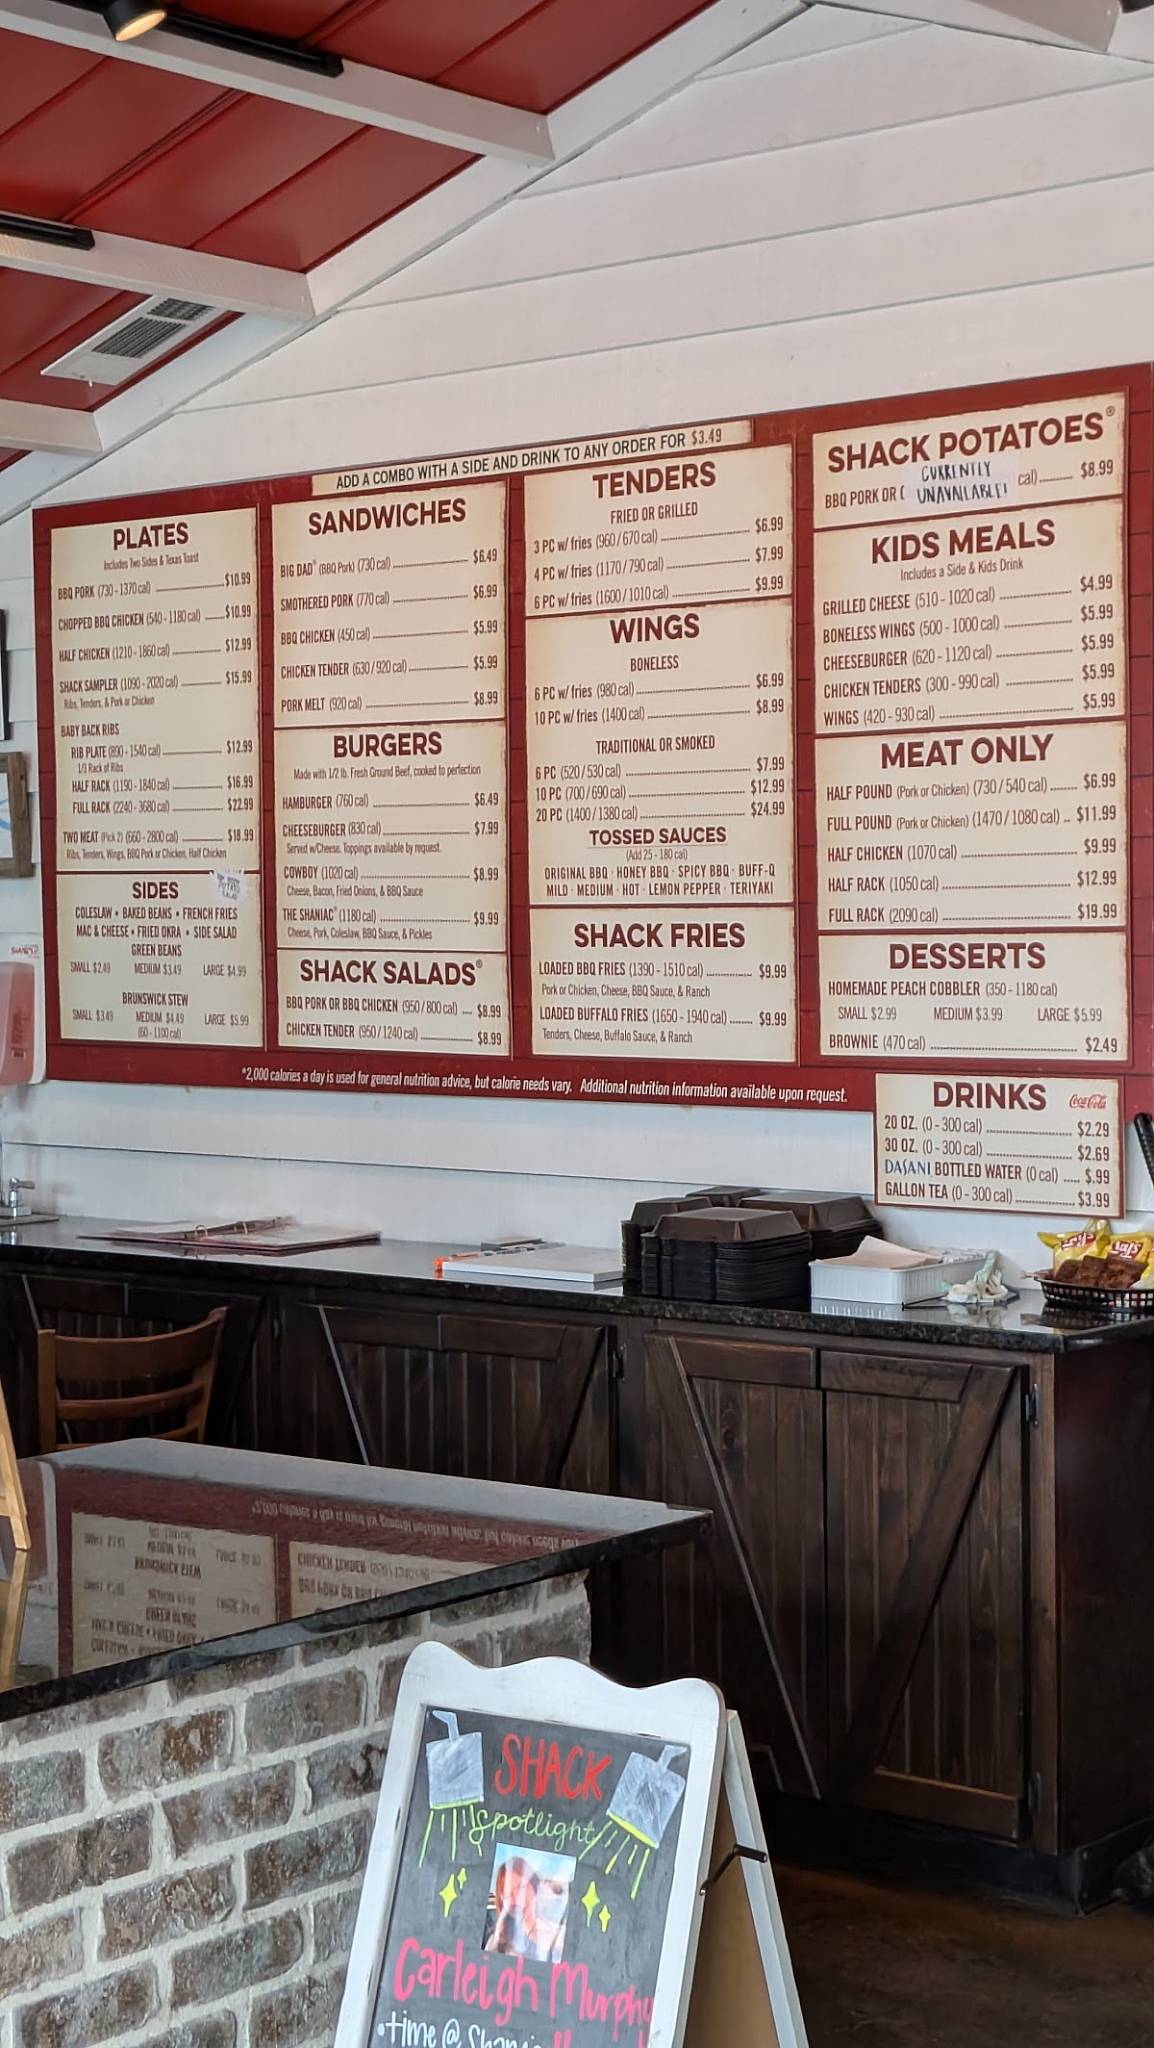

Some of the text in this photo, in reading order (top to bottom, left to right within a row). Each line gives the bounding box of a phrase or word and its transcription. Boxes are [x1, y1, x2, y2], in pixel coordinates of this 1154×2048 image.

[336, 428, 722, 489] ADD A COMBO WITH A SIDE AND DRINK TO ANY ORDER FOR $3.49
[828, 434, 930, 473] SHACK
[592, 461, 716, 498] TENDERS
[922, 461, 991, 481] CURRENTLY
[826, 492, 846, 509] BBQ
[850, 488, 879, 506] PORK
[882, 487, 896, 502] OR
[1081, 459, 1113, 479] $8.99
[309, 498, 466, 535] SANDWICHES
[611, 502, 698, 524] FRIED OR GRILLED
[114, 522, 188, 550] PLATES
[872, 519, 1055, 564] KIDS MEALS
[58, 572, 250, 600] BBQ PORK $10.99
[281, 584, 497, 612] SMOTHERED PORK $6.99
[823, 574, 1112, 616] GRILLED CHEESE $4.99
[58, 604, 251, 631] CHOPPED BBQ CHICKEN $10.99
[610, 613, 699, 644] WINGS
[823, 604, 1113, 644] BONELESS WINGS $5.99
[281, 620, 497, 646] BBQ CHICKEN $5.99
[59, 637, 251, 663] HALF CHICKEN $12.99
[824, 633, 1114, 671] CHEESEBURGER $5.99
[281, 655, 497, 679] CHICKEN TENDER $5.99
[631, 655, 678, 672] BONELESS
[60, 670, 252, 694] SHACK SAMPLER $15.99
[824, 663, 1114, 699] CHICKEN TENDERS $5.99
[281, 691, 498, 712] PORK MELT $8.99
[61, 723, 119, 738] BABY BACK RIBS
[334, 732, 442, 758] BURGERS
[596, 735, 715, 754] TRADITIONAL OR SMOKED
[882, 734, 1053, 769] MEAT ONLY
[827, 772, 1116, 801] HALF POUND $6.99
[282, 792, 498, 810] HAMBURGER $6.49
[536, 801, 784, 822] 20 PC $24.99
[282, 821, 498, 837] CHEESEBURGER $7.99
[828, 805, 1116, 832] FULL POUND $11.99
[589, 826, 726, 846] TOSSED SAUCES
[828, 838, 1116, 862] HALF CHICKEN $9.99
[284, 866, 498, 882] COWBOY $8.99
[133, 882, 178, 899] SIDES
[76, 906, 238, 920] COLESLAW BAKED BEANS FRENCH FRIES
[574, 923, 745, 948] SHACK FRIES
[890, 942, 1045, 969] DESSERTS
[300, 959, 377, 984] SHACK
[539, 961, 786, 980] LOADED BBQ FRIES $9.99
[122, 992, 188, 1006] BRUNSWICK STEW
[828, 981, 980, 996] HOMEMADE PEACH COBBLER
[540, 1006, 786, 1026] LOADED BUFFALO FRIES $9.99
[830, 1034, 1117, 1054] BROWNIE $2.49
[580, 1078, 847, 1103] Additional nutrition information available upon request.
[934, 1082, 1046, 1110] DRINKS
[884, 1114, 1109, 1138] 20 OZ. $2.29
[885, 1137, 1109, 1162] 30 OZ. $2.69
[885, 1159, 1110, 1184] DASANI BOTTLED WATER $.99
[886, 1182, 1110, 1208] GALLON TEA $3.99
[495, 1732, 613, 1802] SHACK
[394, 1936, 539, 2027] Carleigh
